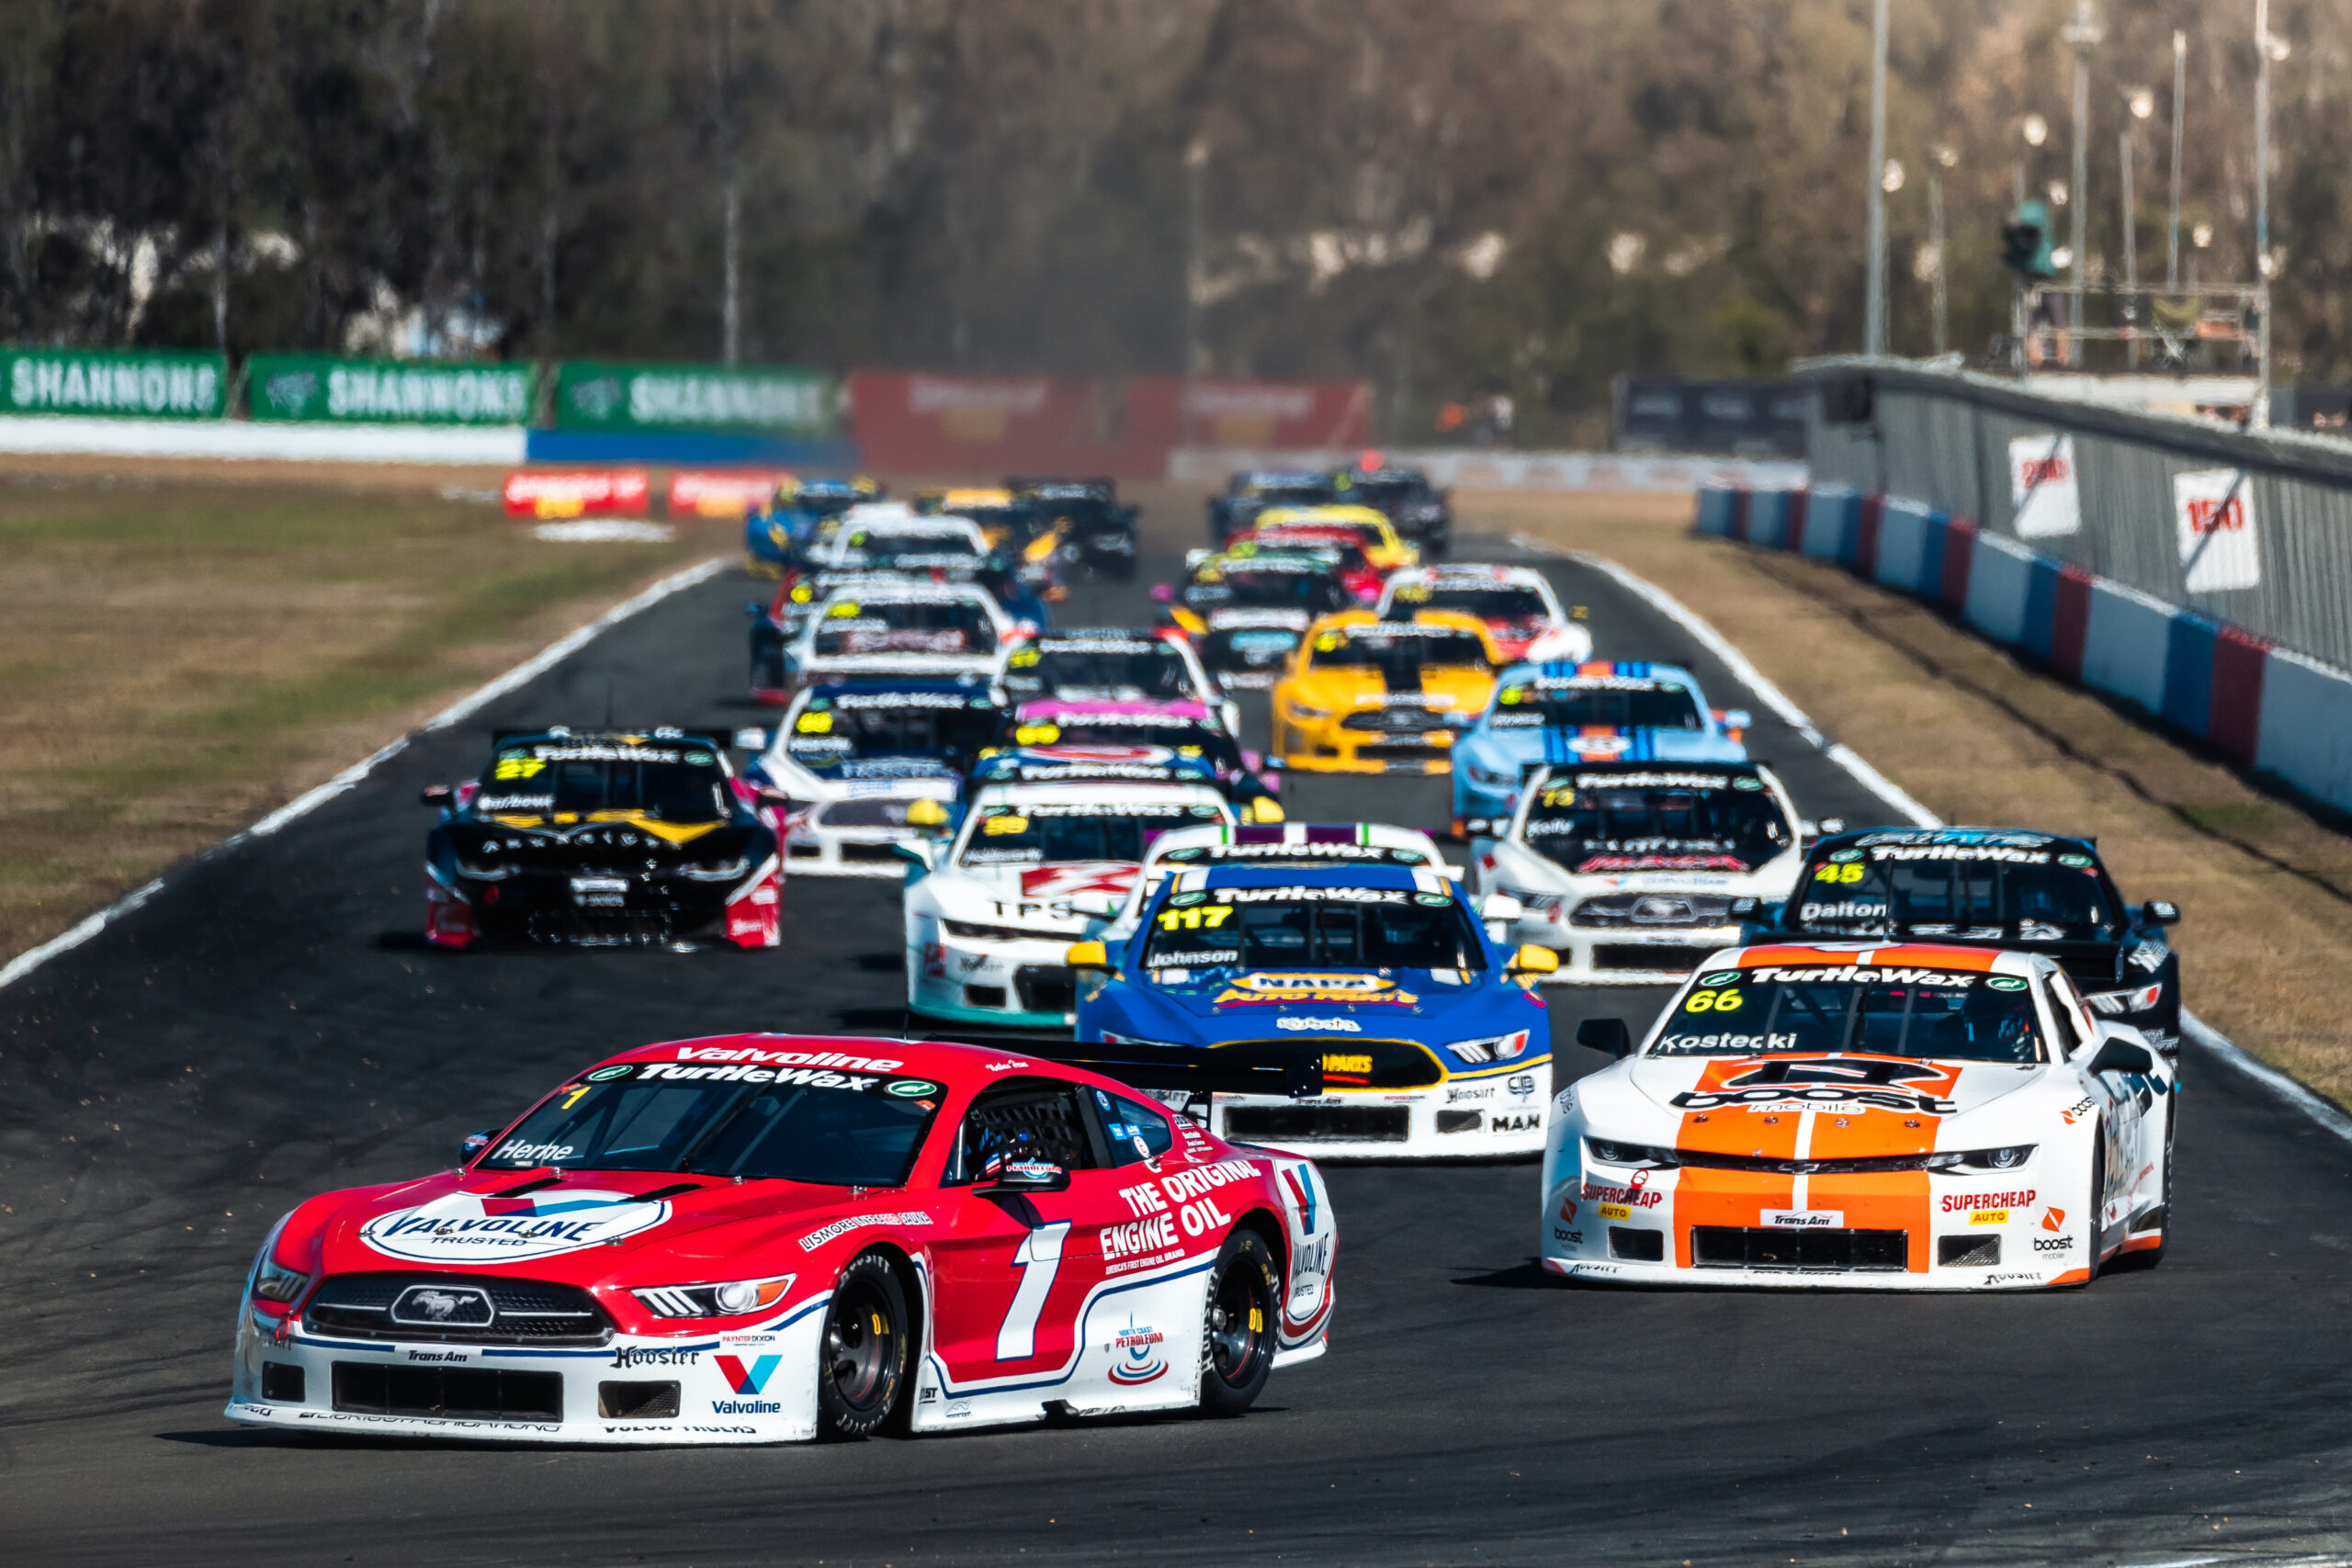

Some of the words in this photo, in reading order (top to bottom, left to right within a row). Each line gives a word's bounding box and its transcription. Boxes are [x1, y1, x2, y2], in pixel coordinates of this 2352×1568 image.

[11, 357, 216, 412] SHANNONS
[328, 366, 526, 418] SHANNONS
[1871, 844, 2051, 864] TurtleWax
[1815, 862, 1866, 884] 45
[1215, 886, 1409, 905] TurtleWax
[1158, 906, 1234, 931] 117
[1800, 902, 1888, 920] Dalton
[1148, 949, 1238, 967] Johnson
[1750, 964, 1976, 987] TurtleWax
[1685, 987, 1744, 1012] 66
[1657, 1032, 1797, 1051] Kostecki
[676, 1046, 904, 1072] Valvoline
[637, 1063, 878, 1091] TurtleWax
[561, 1086, 592, 1110] 1
[1668, 1089, 1958, 1116] boost
[1492, 1112, 1541, 1132] MAN
[1118, 1181, 1169, 1218] THE
[1160, 1159, 1261, 1203] ORIGINAL
[1580, 1182, 1661, 1209] SUPERCHEAP
[1600, 1206, 1627, 1218] AUTO
[1941, 1189, 2037, 1213] SUPERCHEAP
[1774, 1215, 1806, 1226] Trans
[1807, 1215, 1830, 1226] Am
[1973, 1212, 2006, 1222] AUTO
[798, 1218, 856, 1251] LISMORE
[1100, 1212, 1179, 1261] ENGINE
[1181, 1197, 1231, 1237] OIL
[1555, 1226, 1583, 1244] boost
[430, 1235, 528, 1247] TRUSTED
[2033, 1235, 2074, 1251] boost
[995, 1218, 1072, 1363] 1
[1115, 1332, 1164, 1348] PETROLEUM
[408, 1349, 444, 1362] Trans
[445, 1350, 469, 1362] Am
[609, 1345, 701, 1369] Hoosier
[711, 1400, 781, 1414] Valvoline
